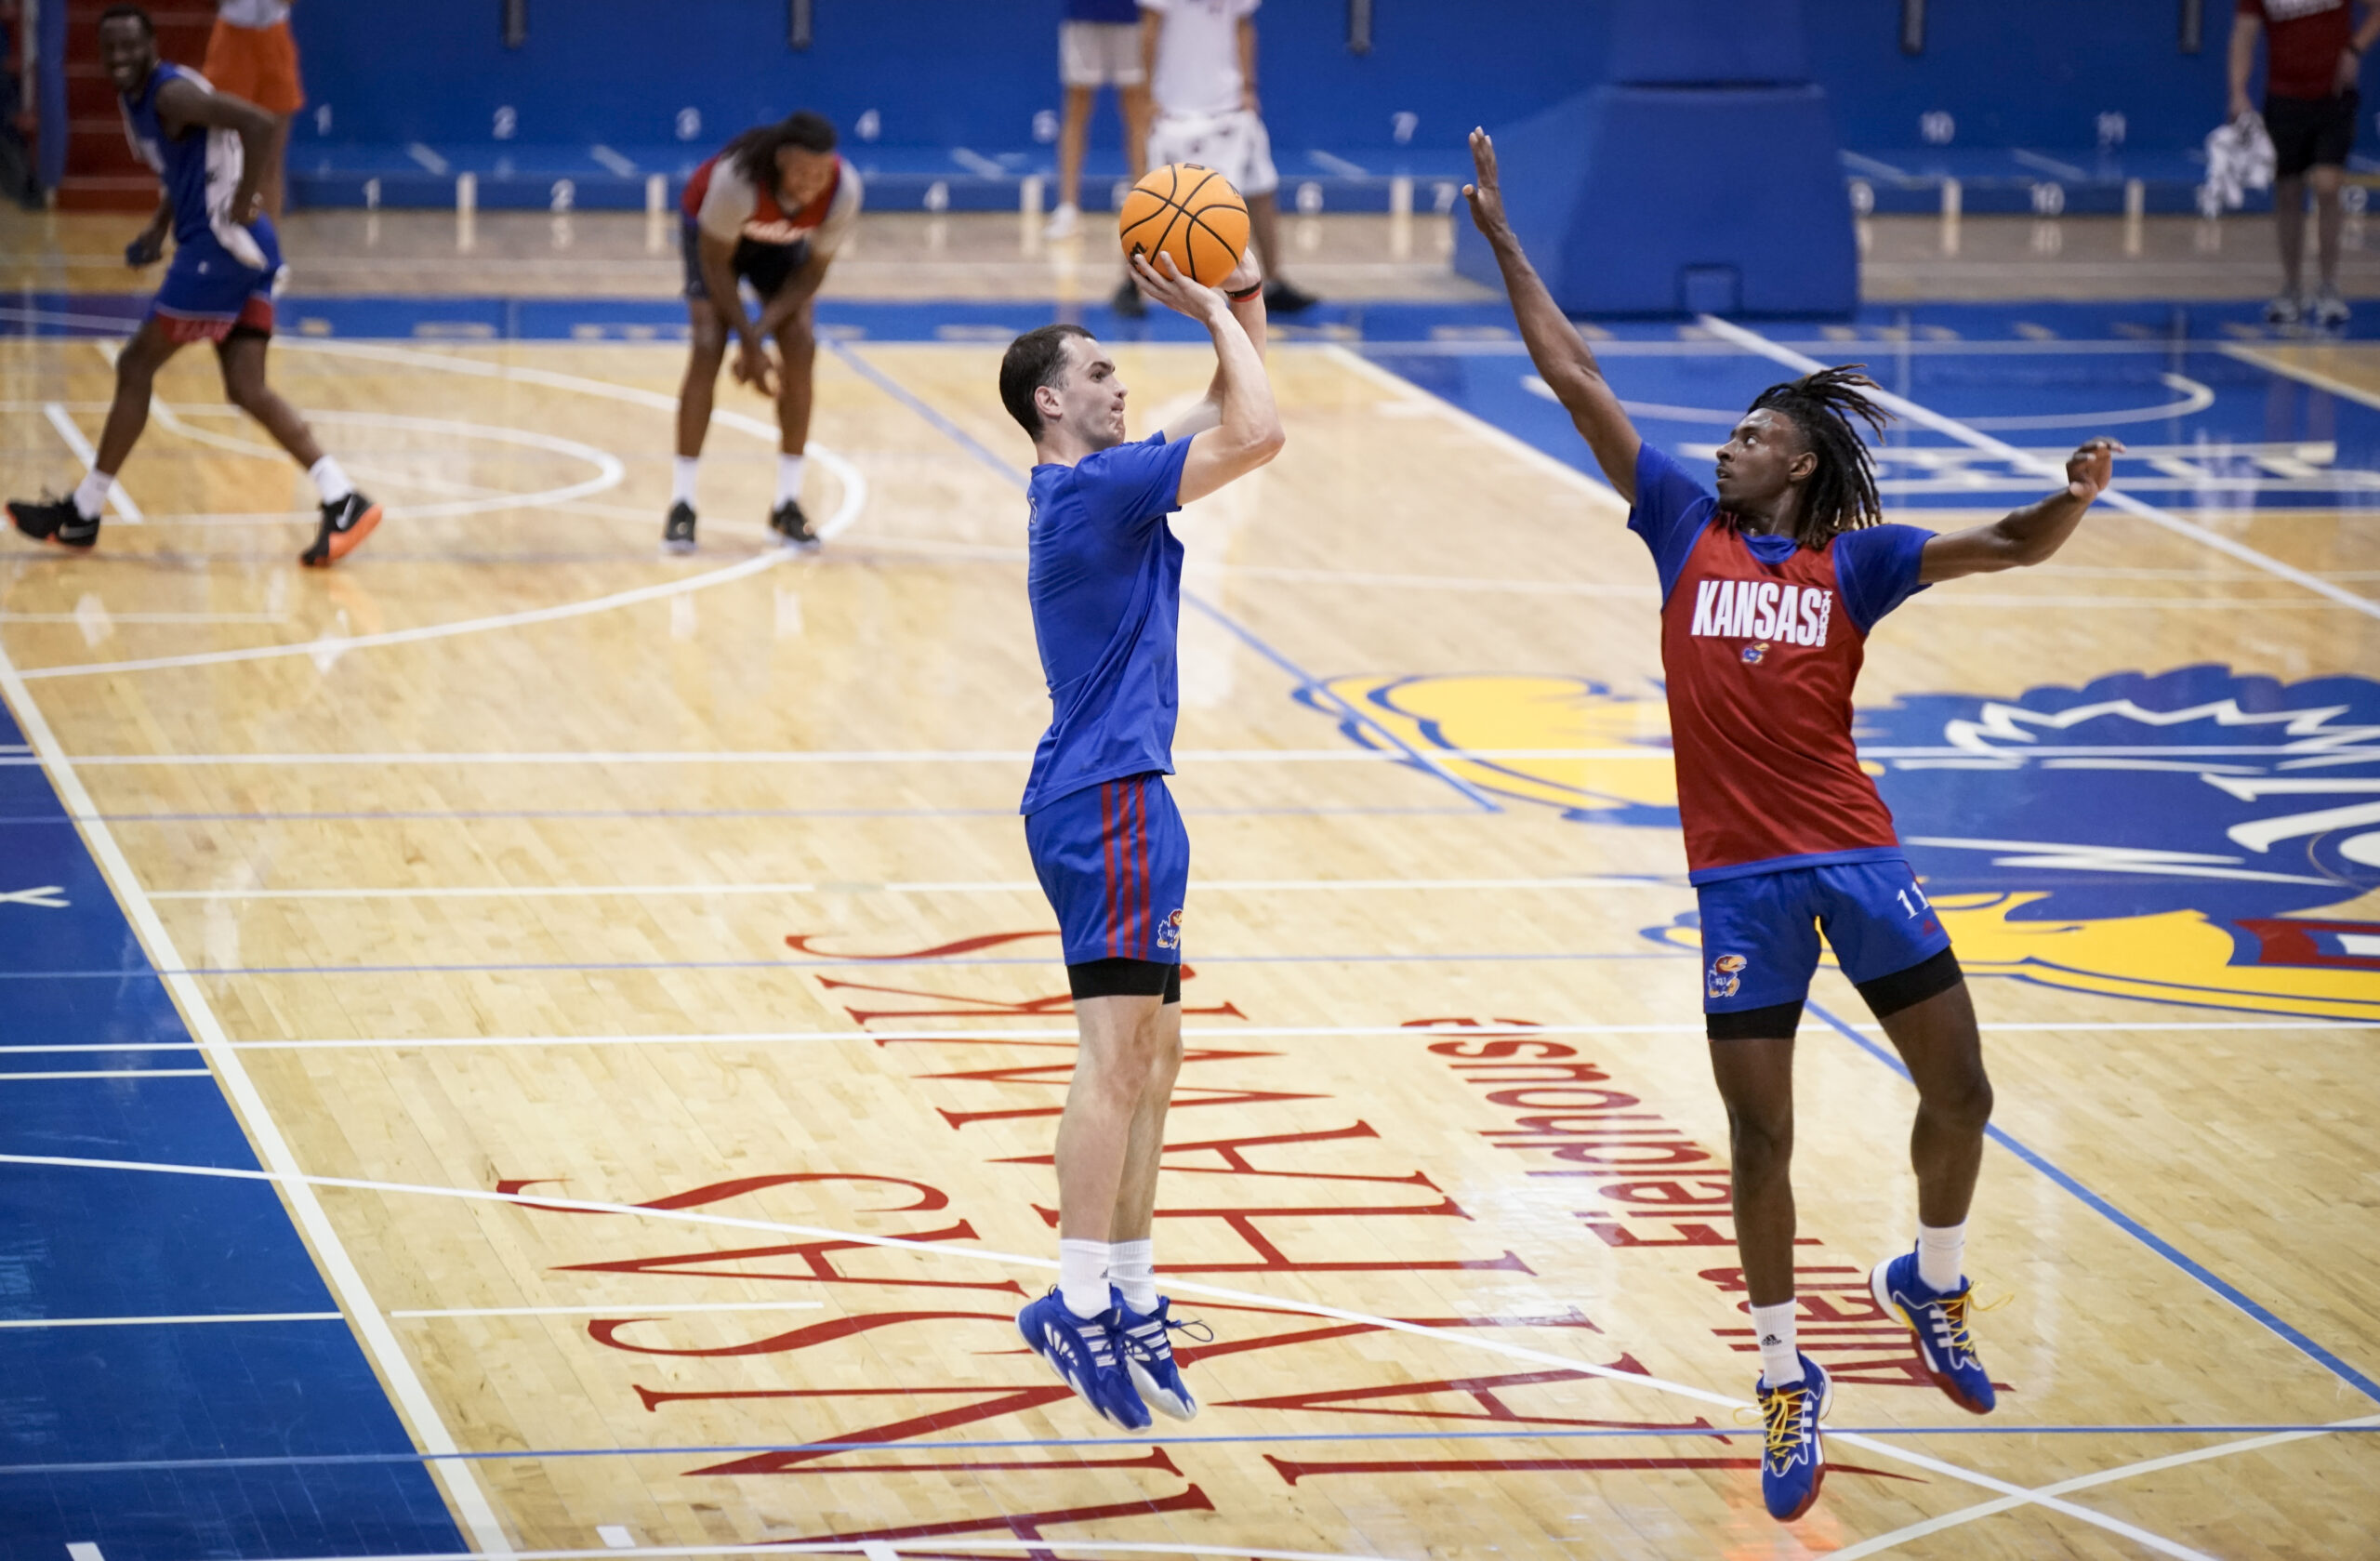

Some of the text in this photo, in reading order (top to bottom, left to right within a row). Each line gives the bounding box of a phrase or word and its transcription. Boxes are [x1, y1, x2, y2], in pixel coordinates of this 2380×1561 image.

[493, 104, 517, 139] 2
[1391, 110, 1420, 145] 7
[550, 178, 575, 213] 2
[1690, 579, 1824, 646] KANSAS
[1897, 881, 1930, 919] 11
